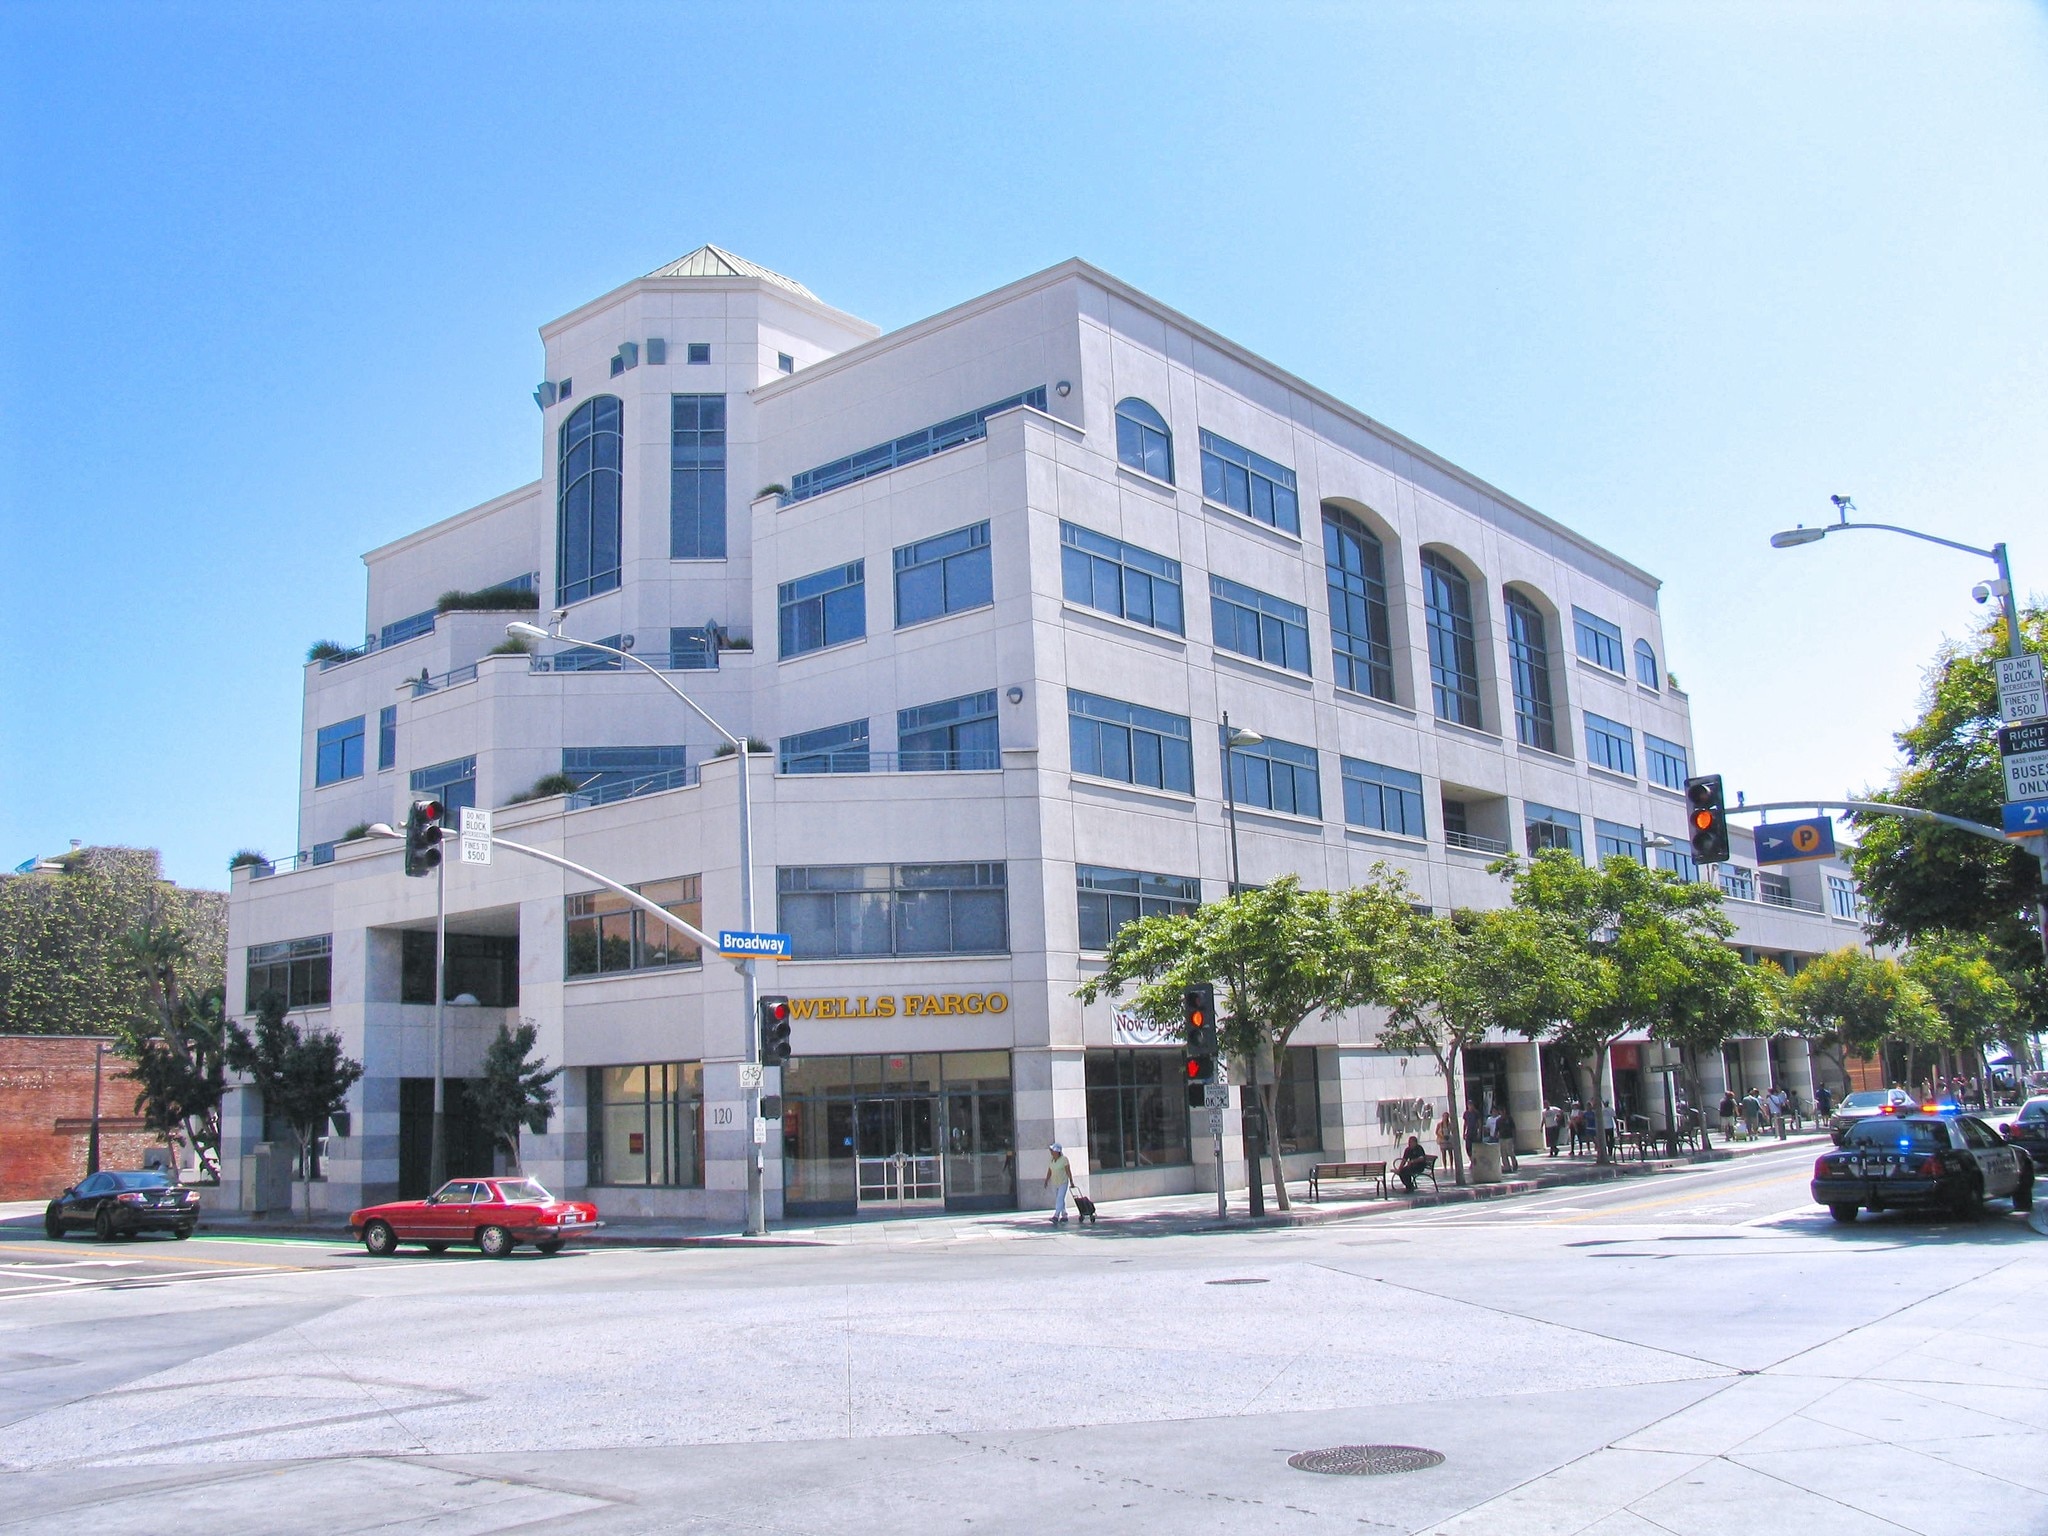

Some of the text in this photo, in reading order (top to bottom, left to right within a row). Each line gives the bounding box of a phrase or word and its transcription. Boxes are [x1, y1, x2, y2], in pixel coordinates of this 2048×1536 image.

[2003, 659, 2031, 672] DO NOT
[2003, 669, 2035, 684] BLOCK
[2001, 681, 2040, 691] INTERSECTION
[2004, 692, 2040, 707] FINES TO
[2010, 703, 2037, 718] $500
[2009, 727, 2045, 741] RIGHT
[2012, 738, 2046, 751] LANE
[2028, 753, 2048, 763] TRANSI
[467, 811, 486, 821] DO NOT
[466, 820, 487, 831] BLOCK
[1800, 830, 1812, 847] P
[465, 842, 488, 851] FINES TO
[467, 850, 486, 861] $500
[723, 933, 785, 955] Broadway
[788, 992, 1009, 1020] WELLS FARGO
[1116, 1014, 1144, 1032] Now
[714, 1107, 733, 1125] 120
[1838, 1155, 1906, 1164] POICE
